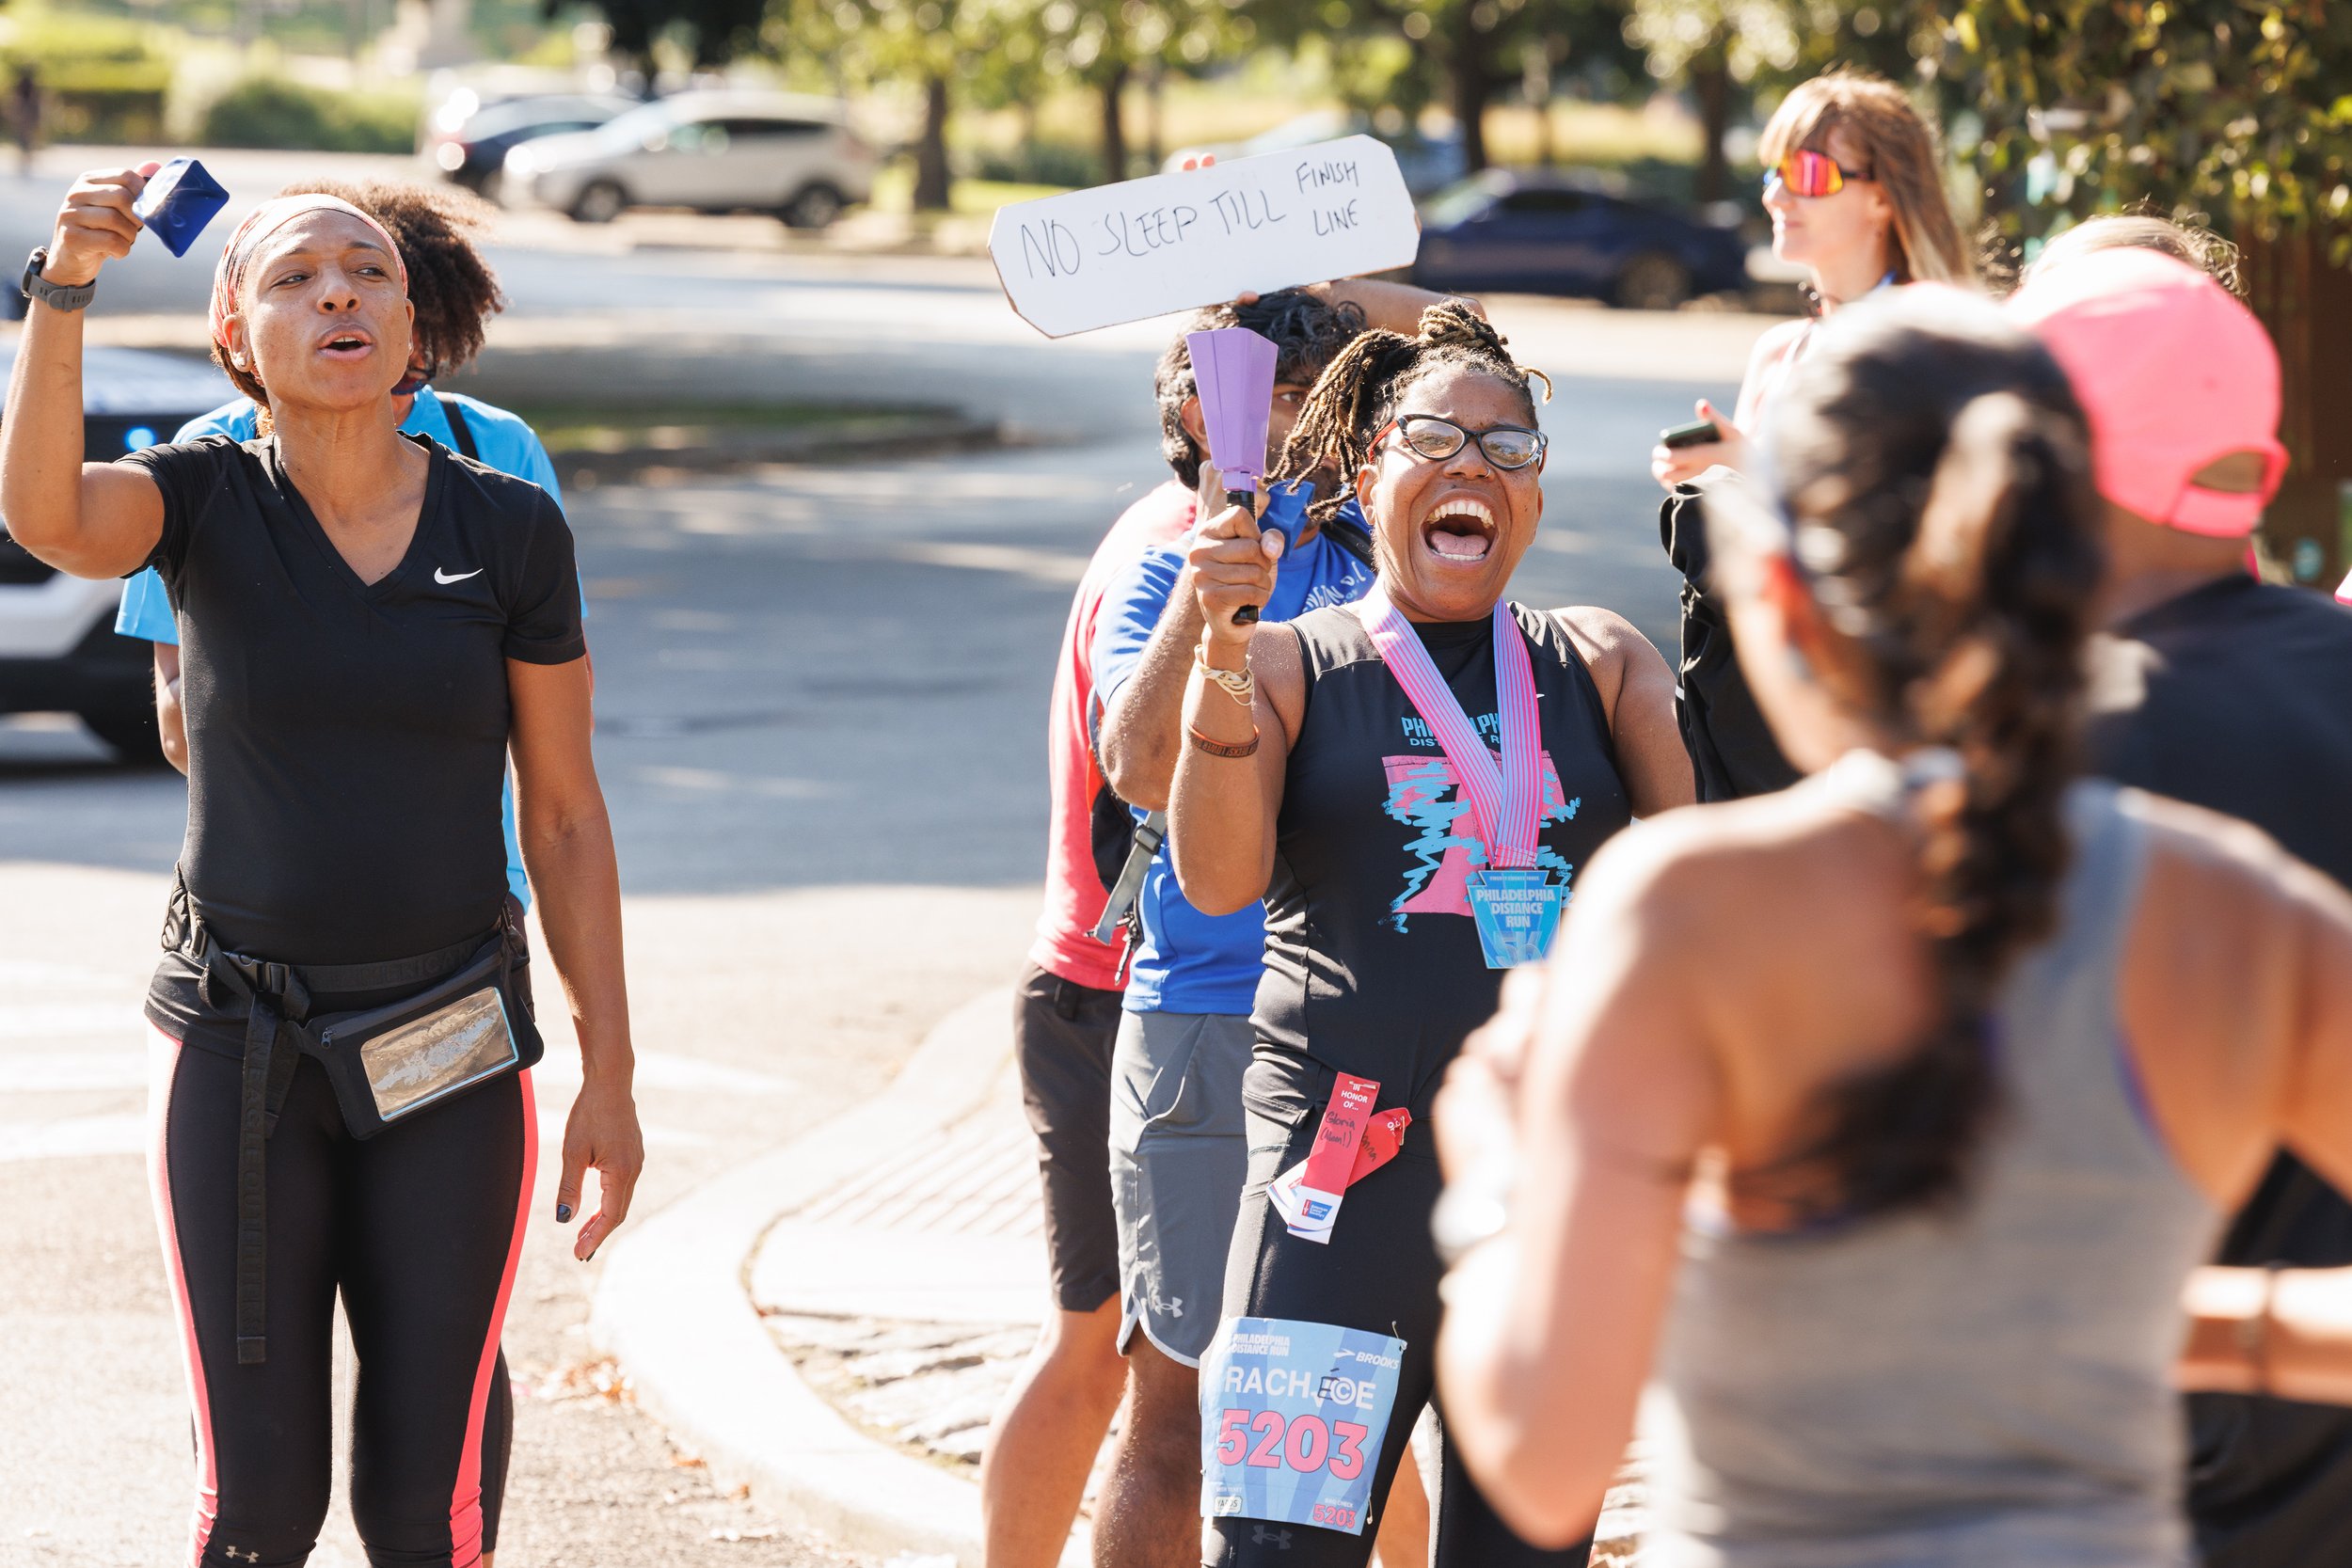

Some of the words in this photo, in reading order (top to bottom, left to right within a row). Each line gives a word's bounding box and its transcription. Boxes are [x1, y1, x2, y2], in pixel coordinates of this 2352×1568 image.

[1020, 218, 1080, 279] NO
[1097, 205, 1198, 257] SLEEP
[1208, 189, 1287, 236] TILL
[1295, 161, 1359, 193] FINISH
[1312, 199, 1359, 237] LINE
[1475, 889, 1556, 902] PHILADELPHIA
[1491, 902, 1544, 915] DISTANCE
[1505, 915, 1532, 928] RUN
[1341, 1090, 1368, 1103] HONOR
[1233, 1333, 1290, 1347] PHILADELPHIA
[1231, 1343, 1269, 1355] DISTANCE
[1269, 1345, 1289, 1356] RUN
[1355, 1351, 1400, 1370] BROOKS
[1216, 1408, 1369, 1481] 5203
[1312, 1503, 1357, 1529] 5203
